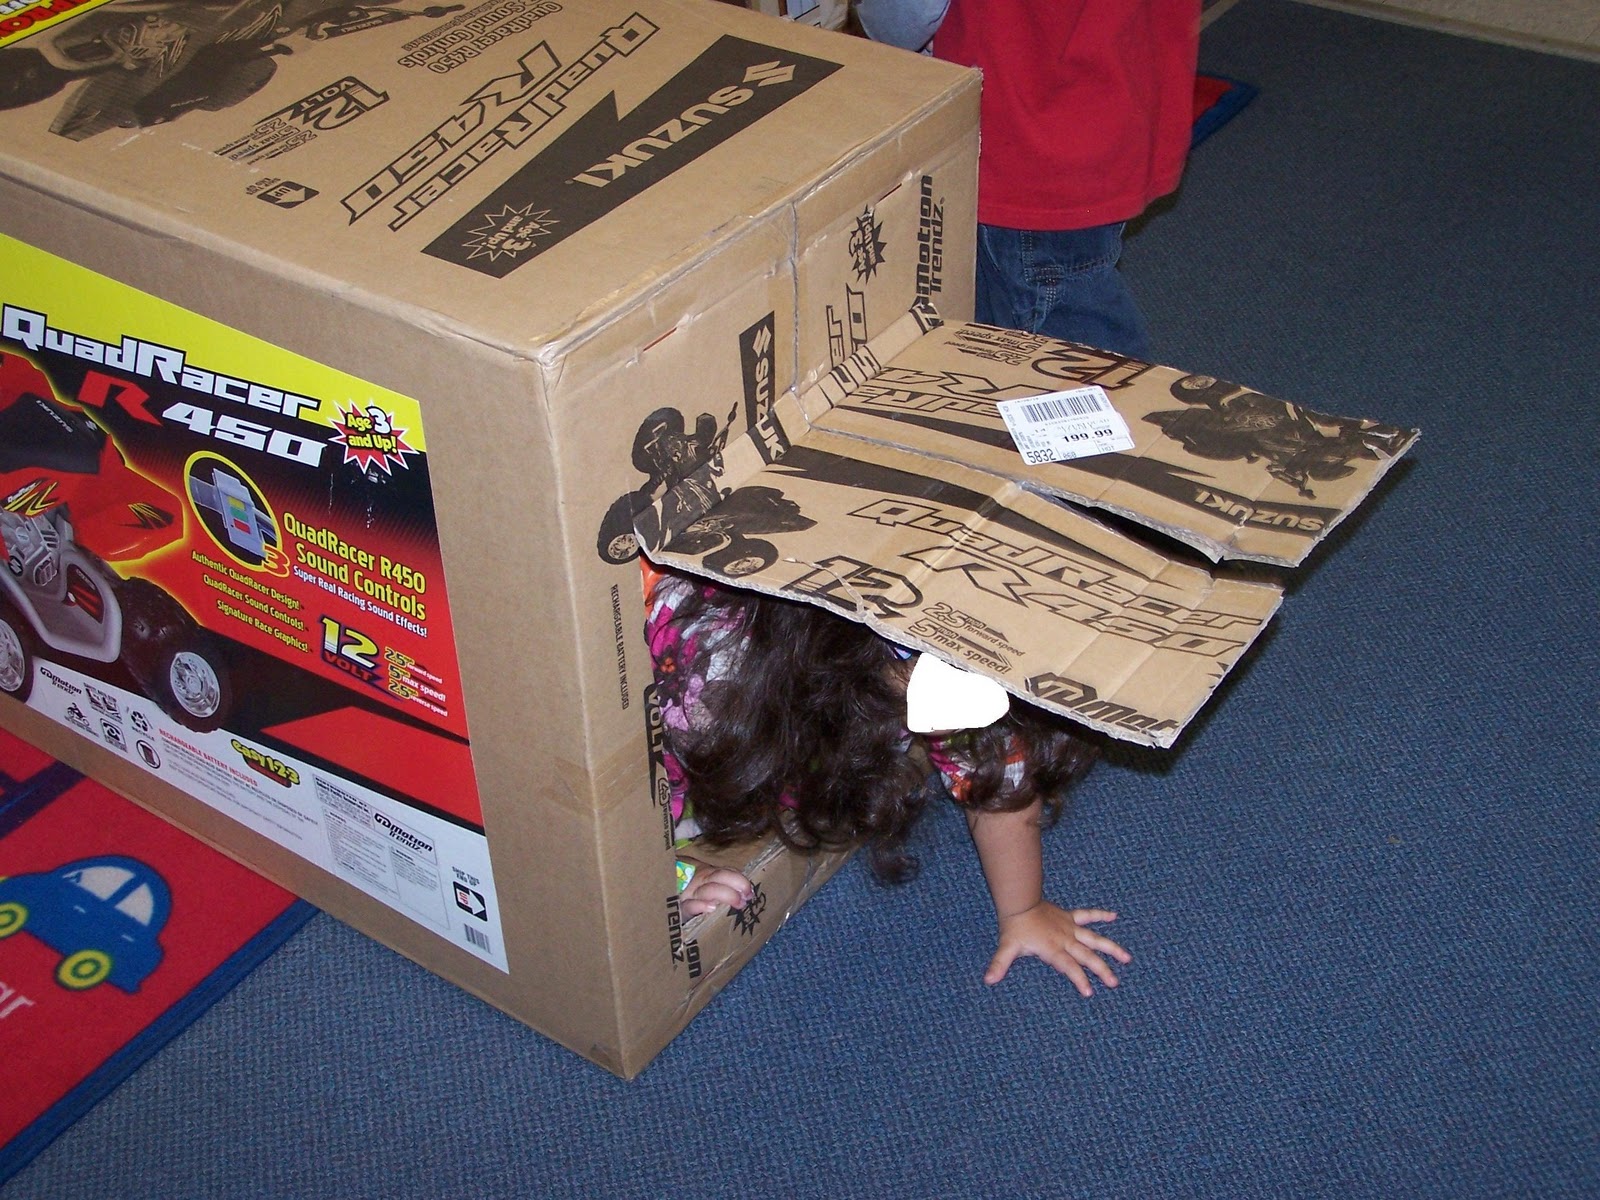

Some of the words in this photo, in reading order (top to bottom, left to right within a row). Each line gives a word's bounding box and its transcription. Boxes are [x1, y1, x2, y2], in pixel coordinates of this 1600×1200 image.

[397, 32, 469, 68] Controls
[300, 80, 356, 112] VOLT
[387, 11, 661, 232] QuadRacer
[571, 85, 755, 188] SUZUKI
[3, 305, 320, 418] QuadRacer
[346, 411, 373, 431] Age
[367, 406, 392, 434] 3
[1062, 427, 1113, 443] 199.99
[348, 432, 374, 451] and
[373, 433, 397, 454] Up!
[1026, 448, 1057, 464] 5832
[1194, 490, 1325, 532] SUZUKI
[283, 512, 375, 571] QuadRacer
[380, 555, 426, 594] R450
[848, 499, 1264, 629] QuadRacer
[192, 550, 229, 575] Authentic
[229, 568, 271, 598] QuadRacer
[270, 588, 300, 610] Design!
[296, 542, 350, 585] Sound
[352, 570, 426, 620] Controls
[203, 574, 244, 601] QuadRacer
[245, 590, 270, 614] Sound
[270, 604, 304, 631] Controls!
[293, 565, 317, 583] Super
[318, 576, 337, 594] Real
[337, 586, 366, 611] Racing
[367, 600, 395, 623] Sound
[395, 615, 428, 638] Effects!
[610, 584, 624, 641] RECHARGEABLE
[217, 599, 254, 626] Signature
[254, 617, 273, 636] Race
[273, 628, 309, 653] Graphics!
[321, 616, 379, 668] 12
[963, 624, 998, 647] forward
[997, 638, 1026, 658] speed
[325, 651, 373, 682] VOLT
[616, 641, 626, 675] BATTERY
[934, 634, 963, 652] max
[962, 648, 1012, 675] speed!
[402, 675, 419, 690] max
[419, 682, 446, 702] speed!
[618, 673, 629, 710] INCLUDED
[231, 738, 266, 768] easy
